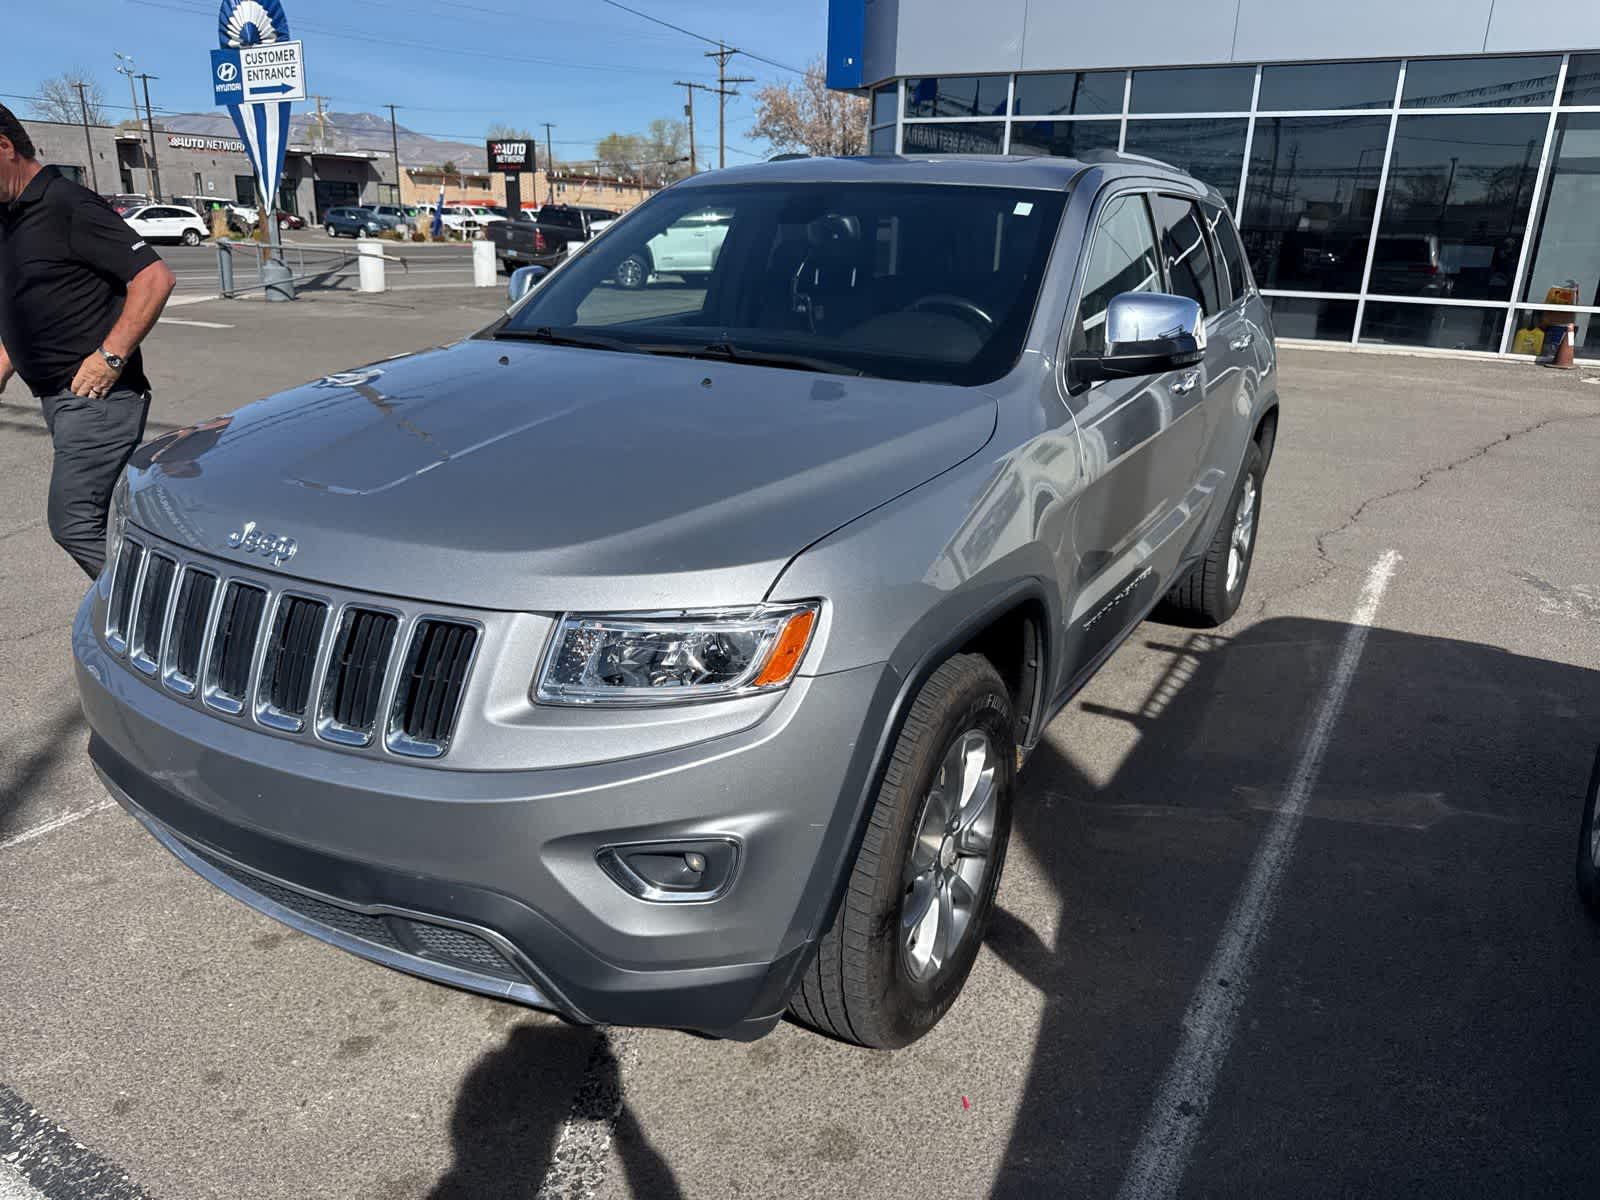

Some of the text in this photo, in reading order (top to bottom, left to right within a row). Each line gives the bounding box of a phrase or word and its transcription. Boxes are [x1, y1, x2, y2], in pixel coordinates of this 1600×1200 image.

[245, 49, 295, 65] CUSTOMER
[247, 66, 296, 81] ENTRANCE
[216, 83, 241, 92] HYUNDAI
[179, 137, 204, 148] AUTO
[501, 143, 526, 155] AUTO
[496, 155, 526, 163] NETWORK
[226, 521, 297, 567] Jeep
